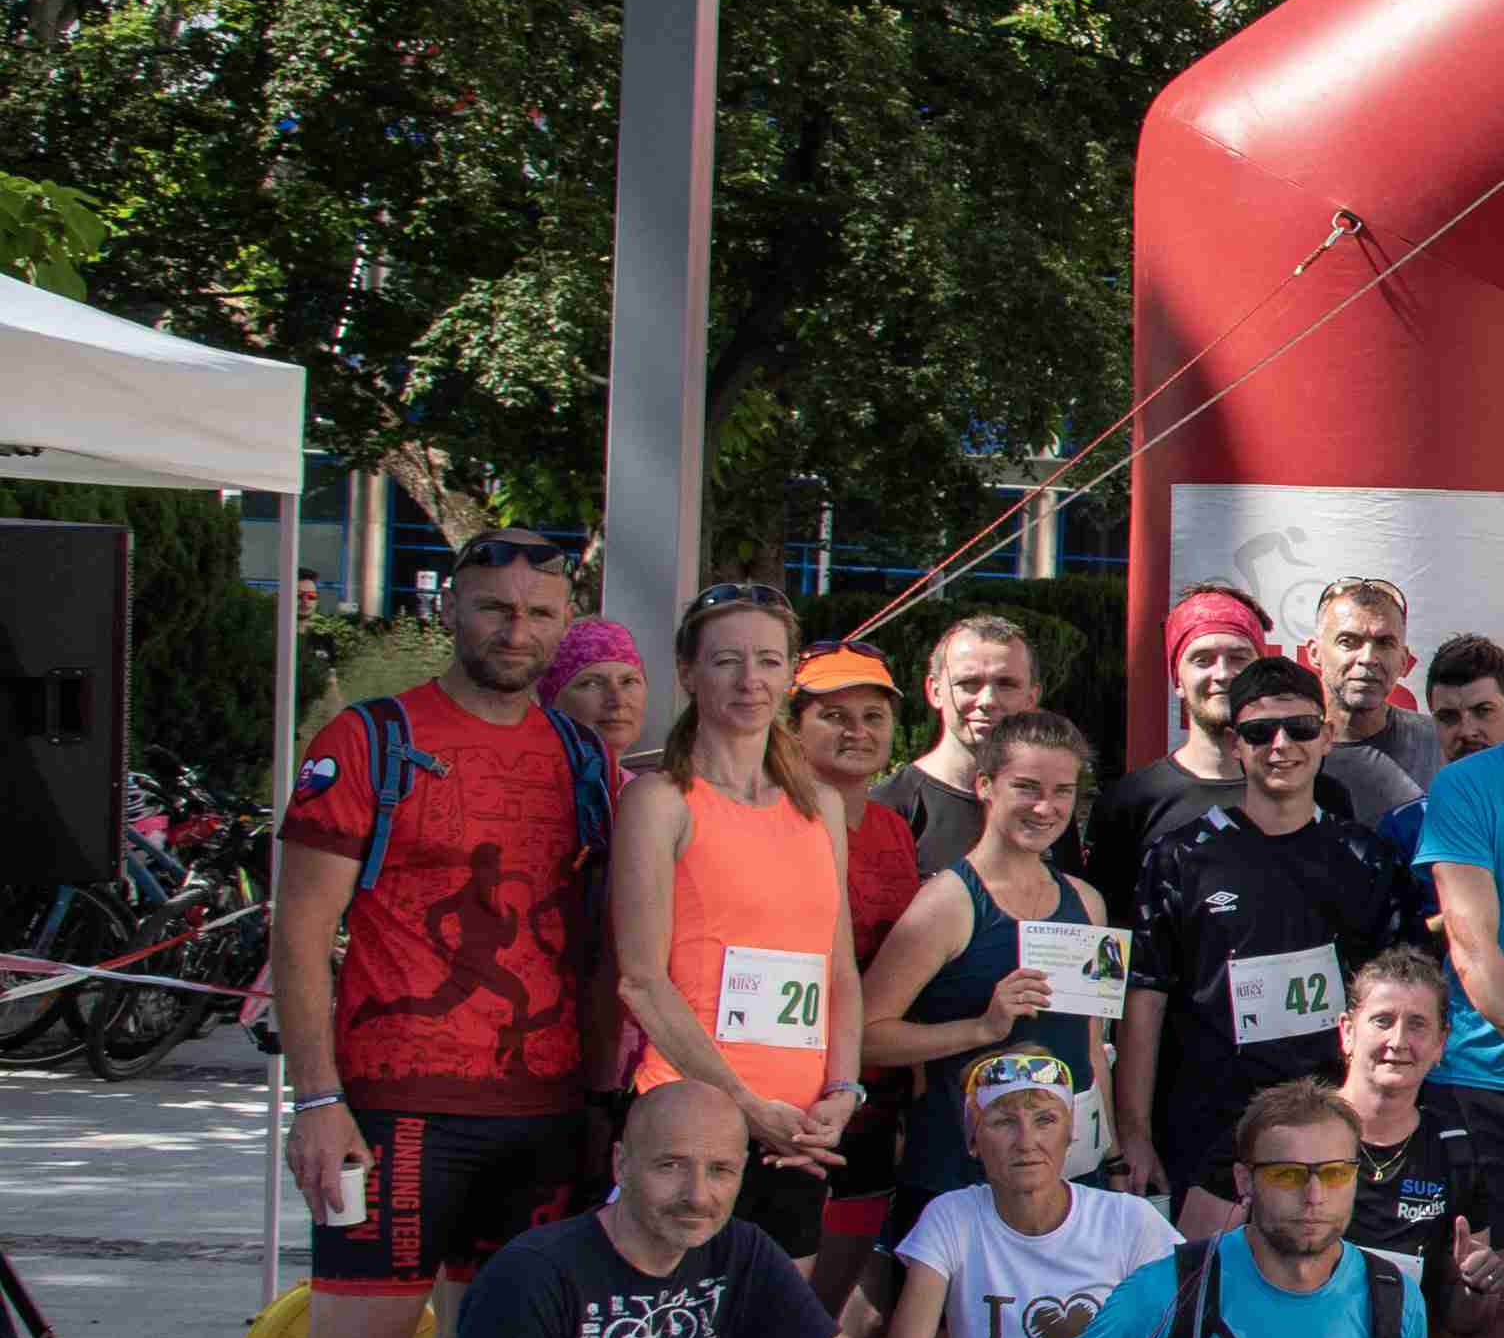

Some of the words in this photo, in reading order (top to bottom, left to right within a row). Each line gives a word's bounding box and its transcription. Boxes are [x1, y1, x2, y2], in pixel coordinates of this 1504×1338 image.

[776, 980, 821, 1028] 20
[1285, 972, 1330, 1015] 42
[392, 1116, 424, 1210] RUNNING
[391, 1213, 421, 1270] TEAM
